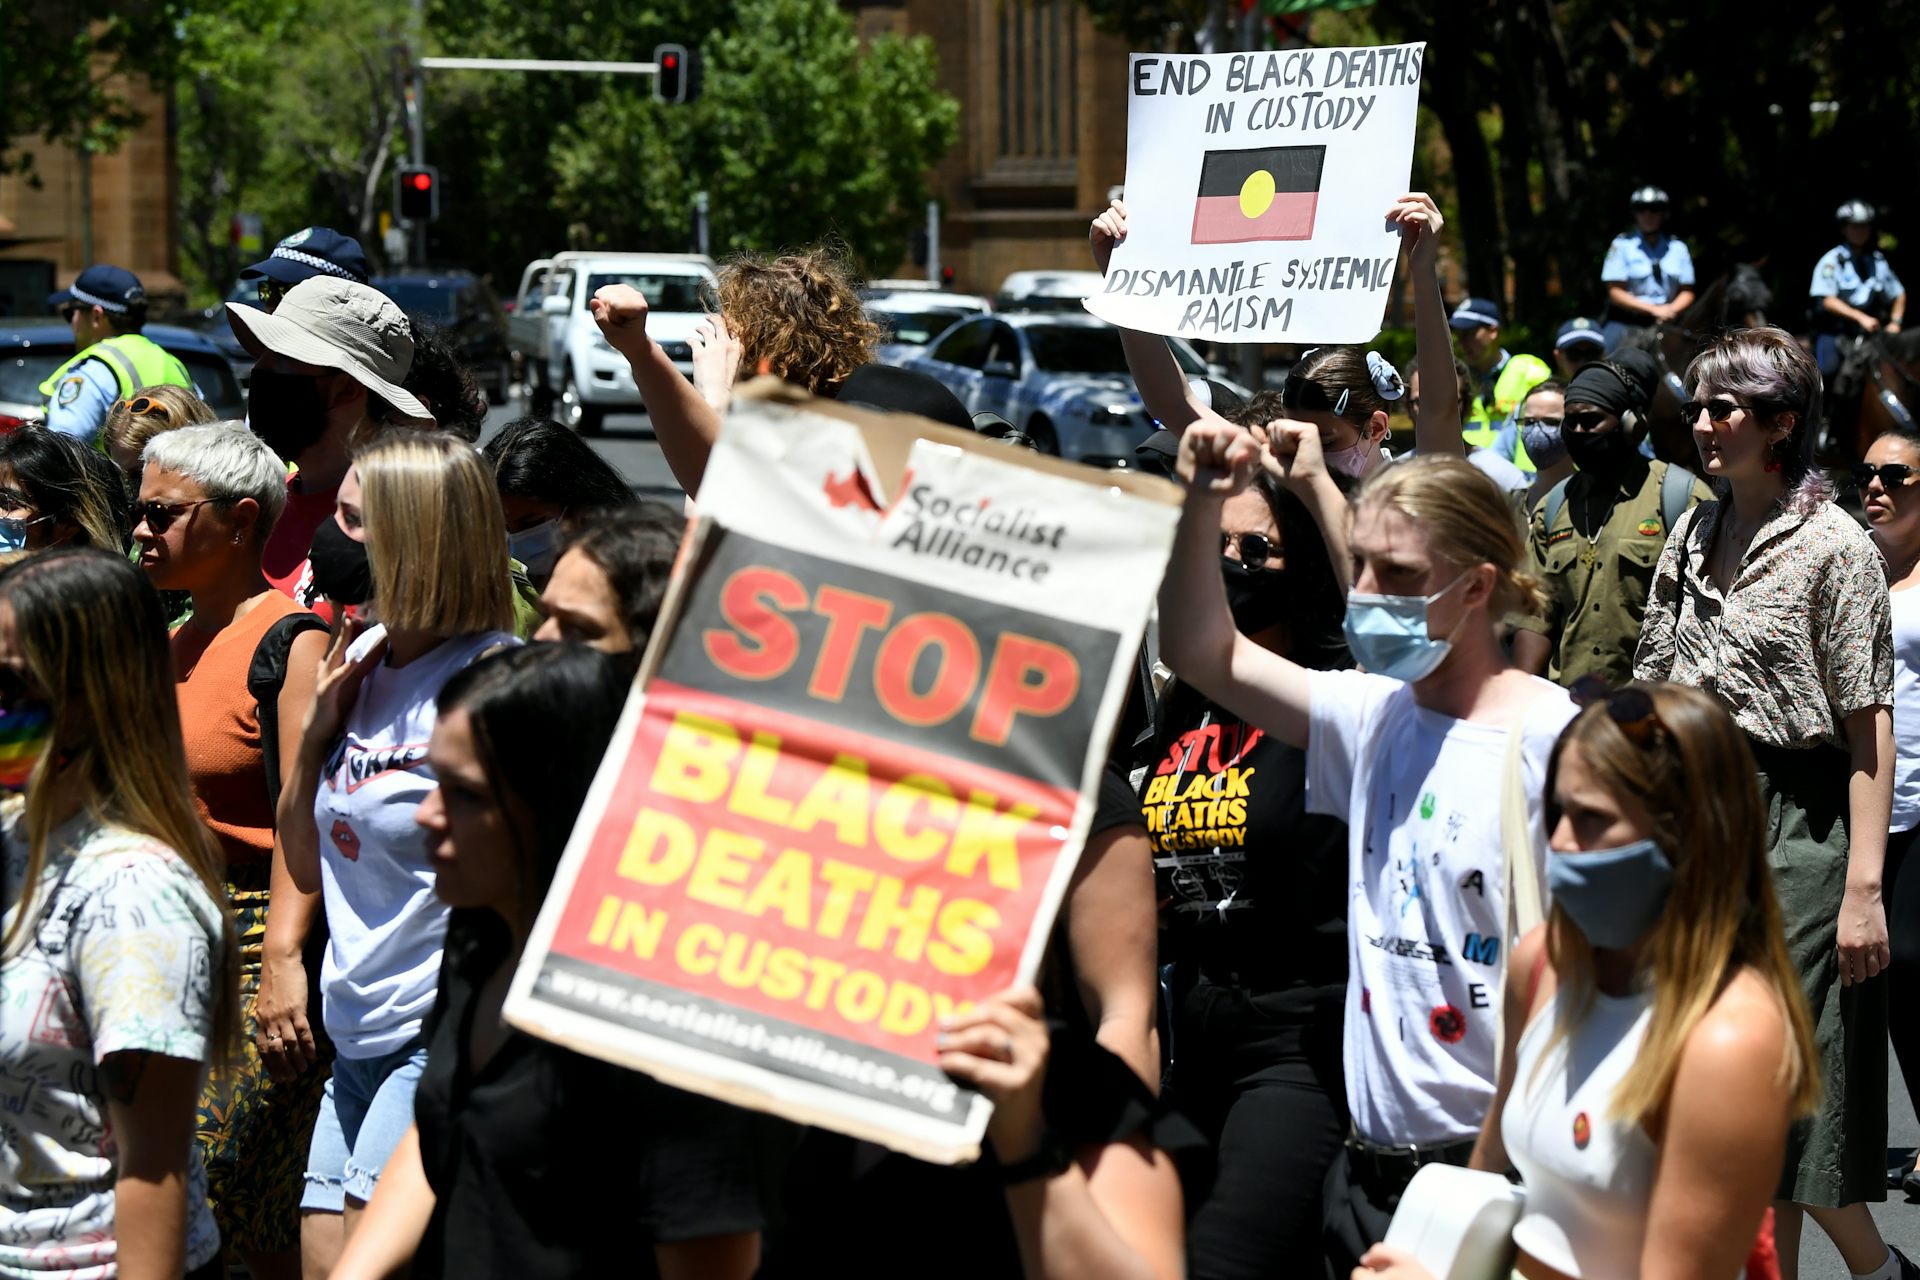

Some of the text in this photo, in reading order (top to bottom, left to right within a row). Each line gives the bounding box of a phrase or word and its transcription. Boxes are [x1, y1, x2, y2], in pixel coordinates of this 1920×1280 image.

[1133, 47, 1422, 96] END BLACK DEATHS
[1204, 91, 1377, 134] IN CUSTODY
[1103, 256, 1394, 297] DISMANTLE SYSTEMIC
[1177, 295, 1294, 334] RACISM
[903, 484, 1067, 549] Socialist
[891, 520, 1051, 583] Alliance
[703, 565, 1081, 747] STOP
[649, 710, 1041, 890] BLACK
[1143, 767, 1256, 804] BLACK
[1160, 826, 1248, 851] CUSTODY
[615, 806, 1003, 977] DEATHS
[587, 896, 669, 961] IN
[550, 968, 958, 1114] www.socialist-alliance.org
